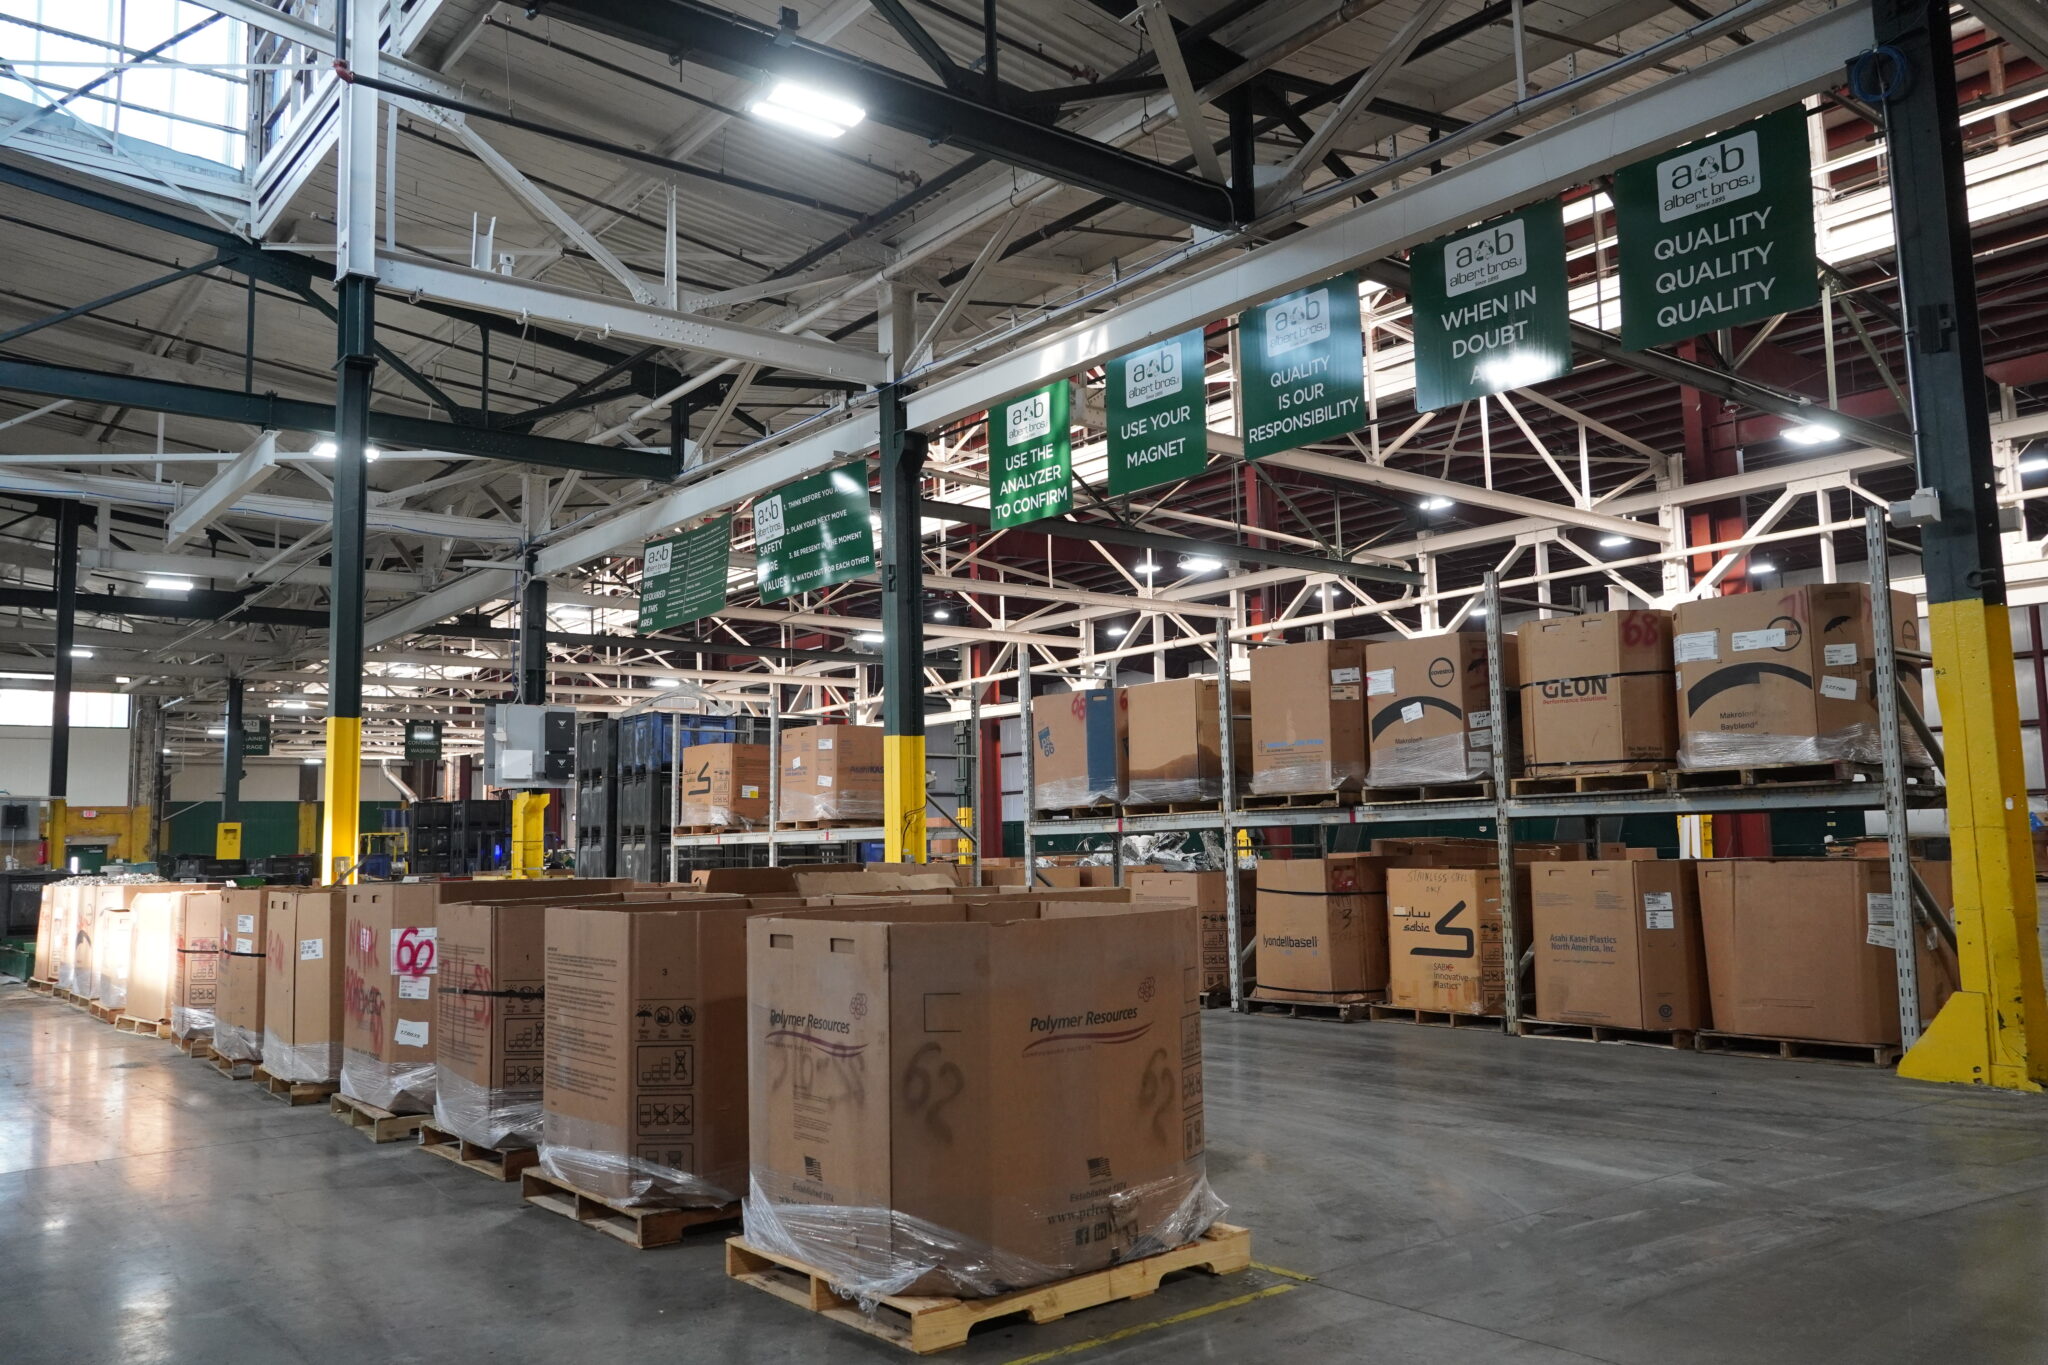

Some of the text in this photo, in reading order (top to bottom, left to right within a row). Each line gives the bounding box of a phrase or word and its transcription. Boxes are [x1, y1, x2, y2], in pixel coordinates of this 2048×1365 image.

[1664, 185, 1709, 212] albert
[1654, 206, 1772, 261] QUALITY
[1449, 268, 1486, 288] albert
[1655, 241, 1774, 294] QUALITY
[1441, 285, 1538, 332] WHEN IN
[1656, 276, 1776, 328] QUALITY
[1452, 320, 1530, 360] DOUBT
[1270, 354, 1331, 388] QUALITY
[1128, 380, 1153, 399] albert
[1278, 382, 1325, 412] IS OUR
[1121, 405, 1191, 440] USE YOUR
[1248, 396, 1360, 444] RESPONSIBILITY
[1005, 443, 1054, 472] USE THE
[1126, 437, 1186, 469] MAGNET
[1000, 465, 1062, 497] ANALYZER
[788, 499, 802, 509] THINK
[802, 492, 821, 504] BEFORE
[821, 488, 834, 498] YOU
[995, 486, 1068, 520] TO CONFIRM
[791, 524, 803, 533] PLAN
[803, 518, 817, 531] YOUR
[818, 514, 831, 526] NEXT
[831, 509, 848, 520] MOVE
[760, 539, 783, 557] SAFETY
[794, 550, 800, 558] BE
[800, 544, 820, 556] PRESENT
[838, 531, 862, 544] MOMENT
[796, 570, 814, 582] WATCH
[813, 567, 825, 576] OUT
[825, 563, 835, 573] FOR
[836, 559, 851, 571] EACH
[851, 555, 870, 567] OTHER
[643, 589, 666, 602] REQUIRED
[644, 580, 654, 590] PPE
[763, 575, 788, 593] VALUES
[641, 603, 658, 615] IN THIS
[640, 618, 653, 628] AREA
[1622, 611, 1659, 647] 68
[1542, 676, 1607, 699] GEON
[1403, 920, 1431, 933] sabic
[1550, 934, 1617, 944] Asahi Kasei Plastics
[1263, 933, 1318, 948] lyondellbasell
[1551, 942, 1617, 953] North America, Inc.
[1433, 972, 1469, 982] Innovative
[770, 1008, 851, 1035] Polymer Resources
[1030, 1007, 1138, 1035] Polymer Resources
